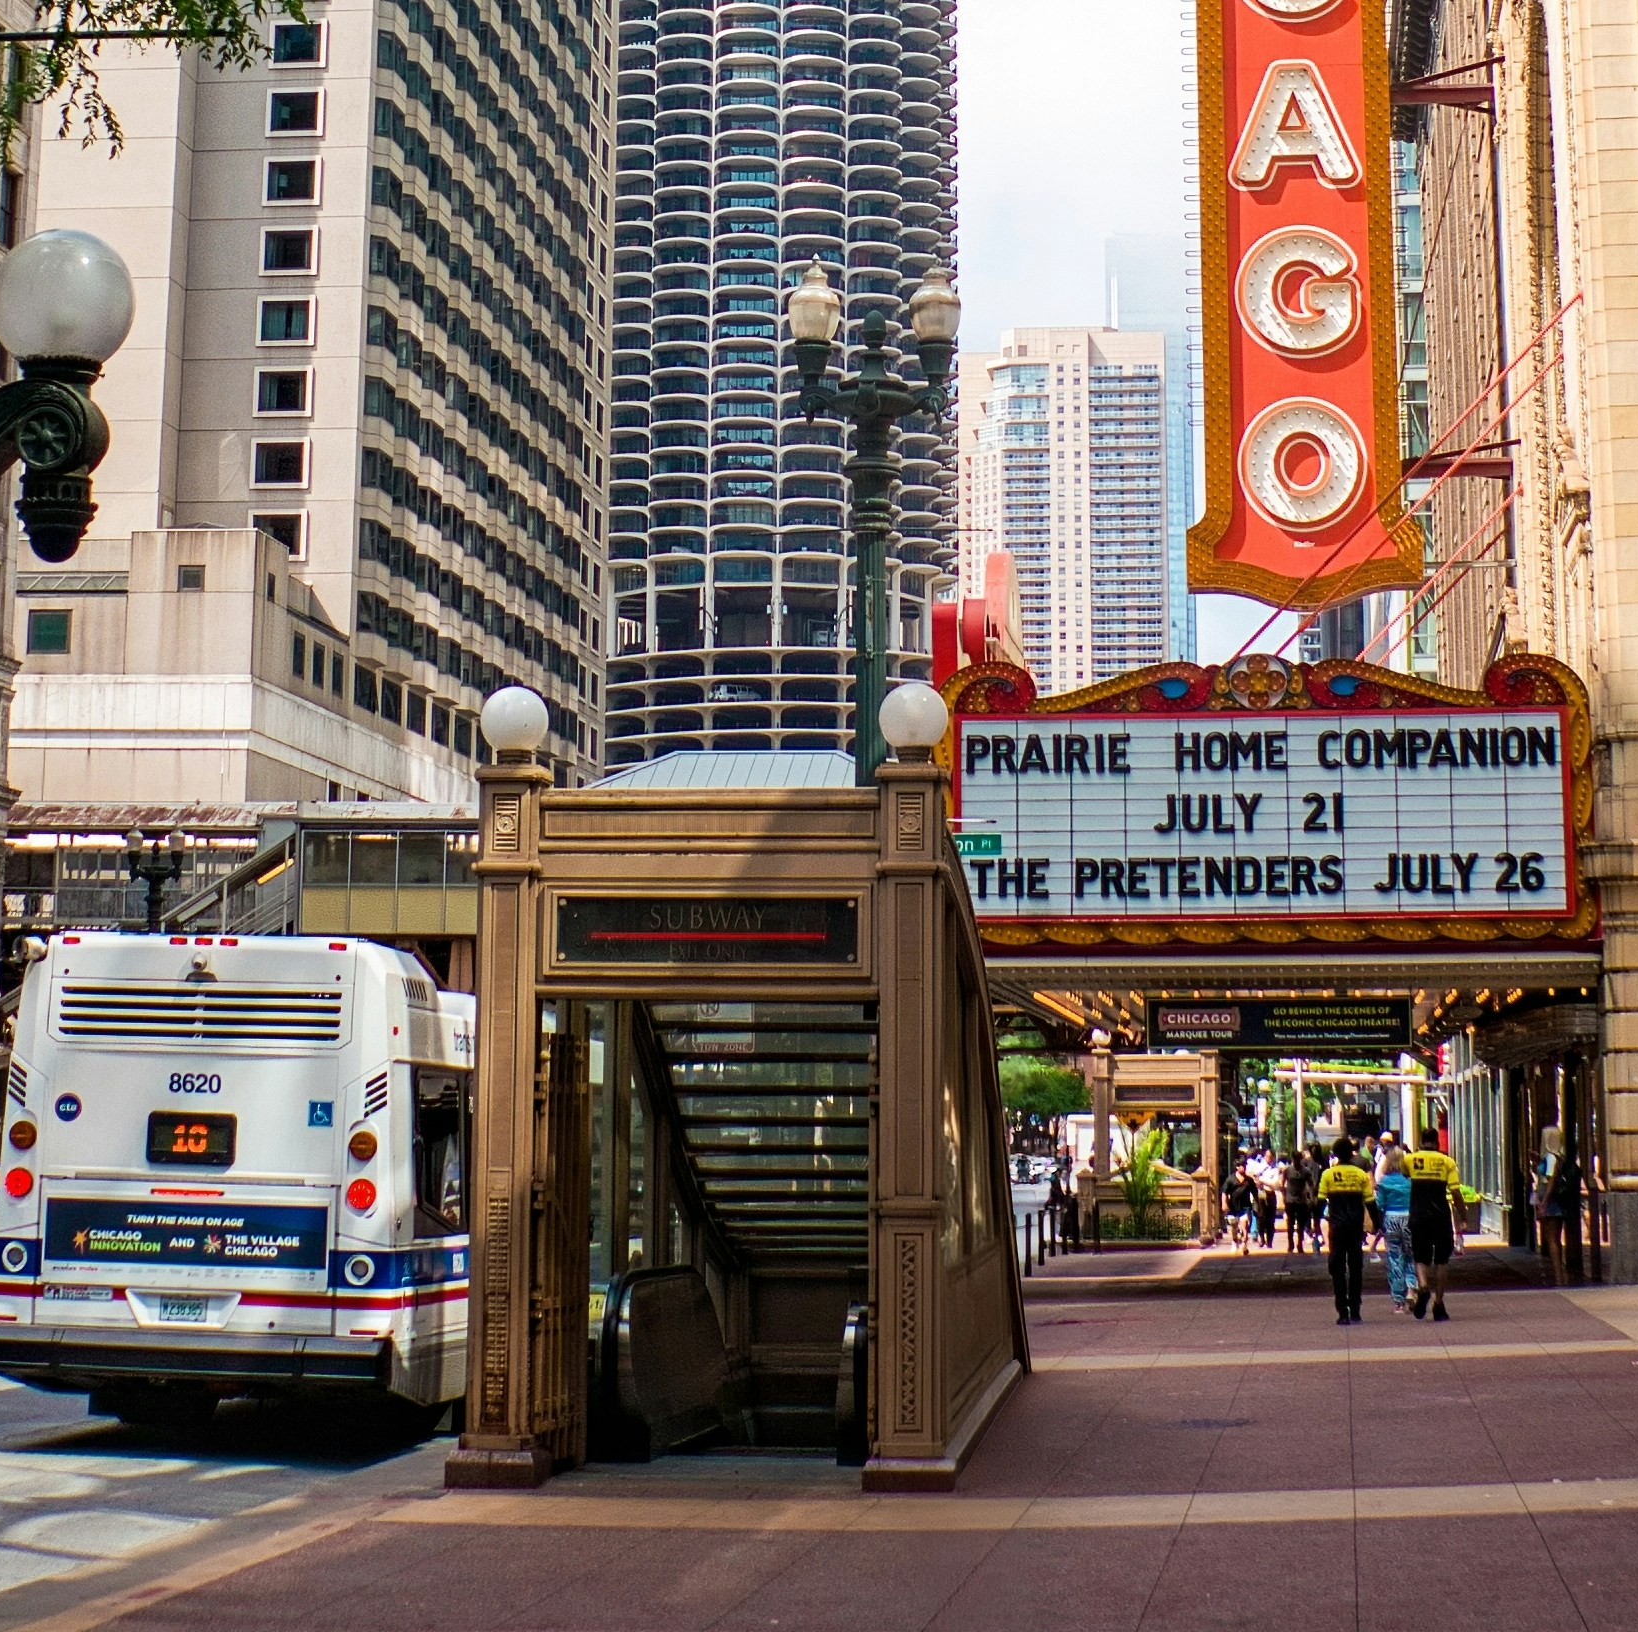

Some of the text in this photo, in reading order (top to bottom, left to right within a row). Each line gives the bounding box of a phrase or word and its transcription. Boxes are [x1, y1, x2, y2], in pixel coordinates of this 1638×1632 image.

[966, 725, 1556, 773] PRAIRIE HOME COMPANION
[1154, 792, 1344, 834] JULY 21
[970, 852, 1545, 898] THE PRETENDERS JULY 26
[649, 904, 766, 930] SUBWAY
[1289, 1006, 1323, 1016] BEHIND
[1324, 1006, 1341, 1015] THE
[1343, 1006, 1376, 1015] SCENES
[1378, 1005, 1391, 1015] OF
[1167, 1014, 1231, 1024] CHICAGO
[1264, 1019, 1281, 1028] THE
[1283, 1019, 1314, 1028] ICONIC
[1316, 1018, 1357, 1027] CHICAGO
[1166, 1030, 1233, 1039] MARQUEE TOUR
[169, 1072, 221, 1093] 8620
[172, 1123, 207, 1153] 10
[127, 1214, 244, 1227] TURN THE PAGE ON AGE
[89, 1229, 142, 1241] CHICAGO
[225, 1234, 300, 1247] THE VILLAGE
[90, 1241, 161, 1252] INNOVATION
[169, 1237, 195, 1248] AND
[225, 1245, 278, 1258] CHICAGO
